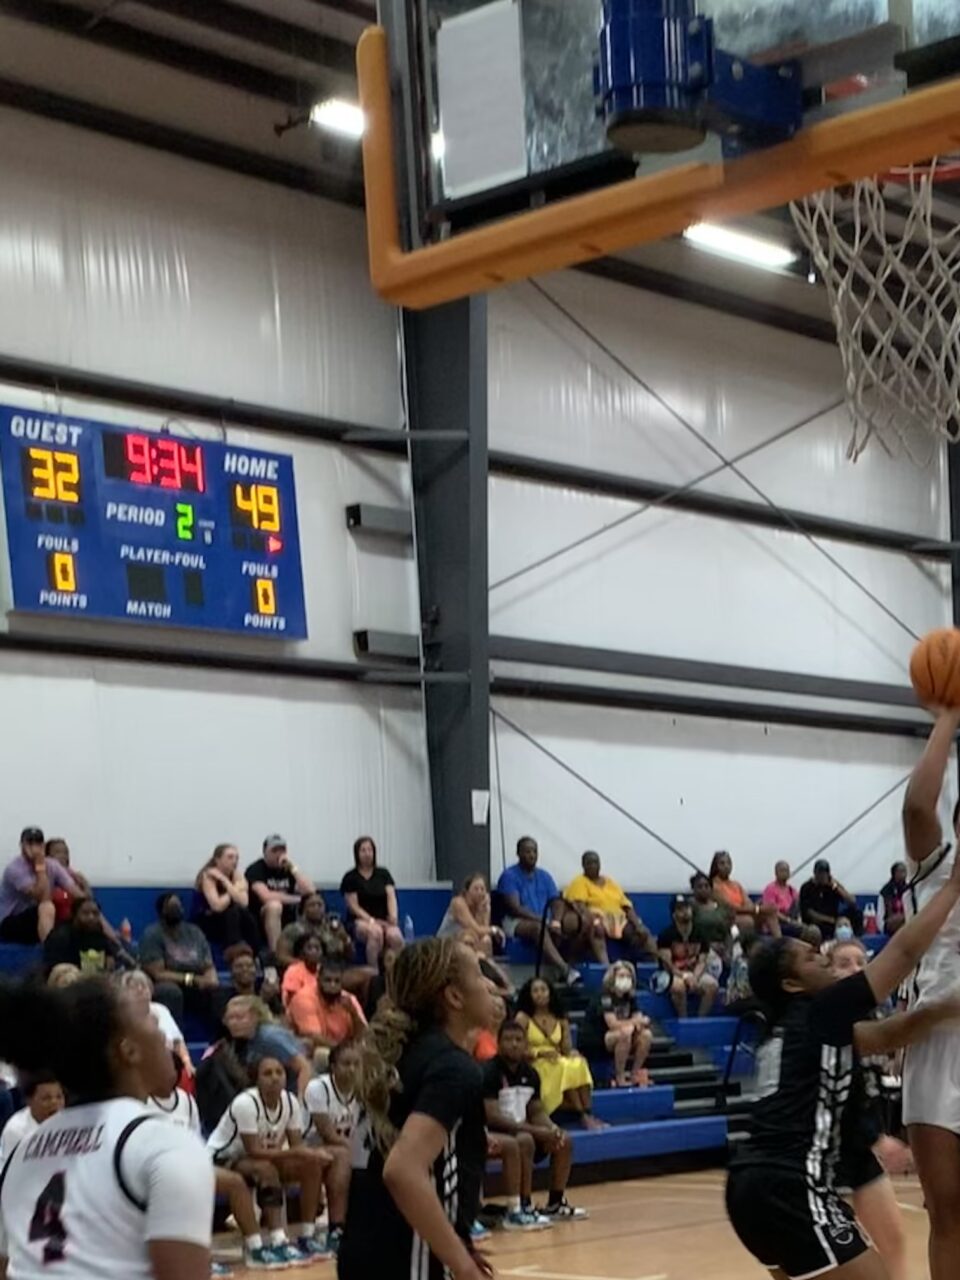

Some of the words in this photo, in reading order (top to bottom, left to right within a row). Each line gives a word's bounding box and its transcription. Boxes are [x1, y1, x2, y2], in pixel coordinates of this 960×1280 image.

[11, 416, 83, 446] GUEST
[28, 447, 80, 503] 32
[125, 433, 206, 492] 9:34
[224, 453, 279, 480] HOME
[106, 502, 165, 527] PERIOD
[175, 502, 194, 540] 2
[235, 483, 280, 533] 49
[37, 534, 79, 553] FOULS
[53, 552, 77, 593] 0
[242, 561, 278, 578] FOULS
[39, 591, 87, 609] POINTS
[126, 600, 171, 618] MATCH
[256, 578, 277, 615] 0
[244, 613, 286, 631] POINTS
[29, 1170, 68, 1267] 4
